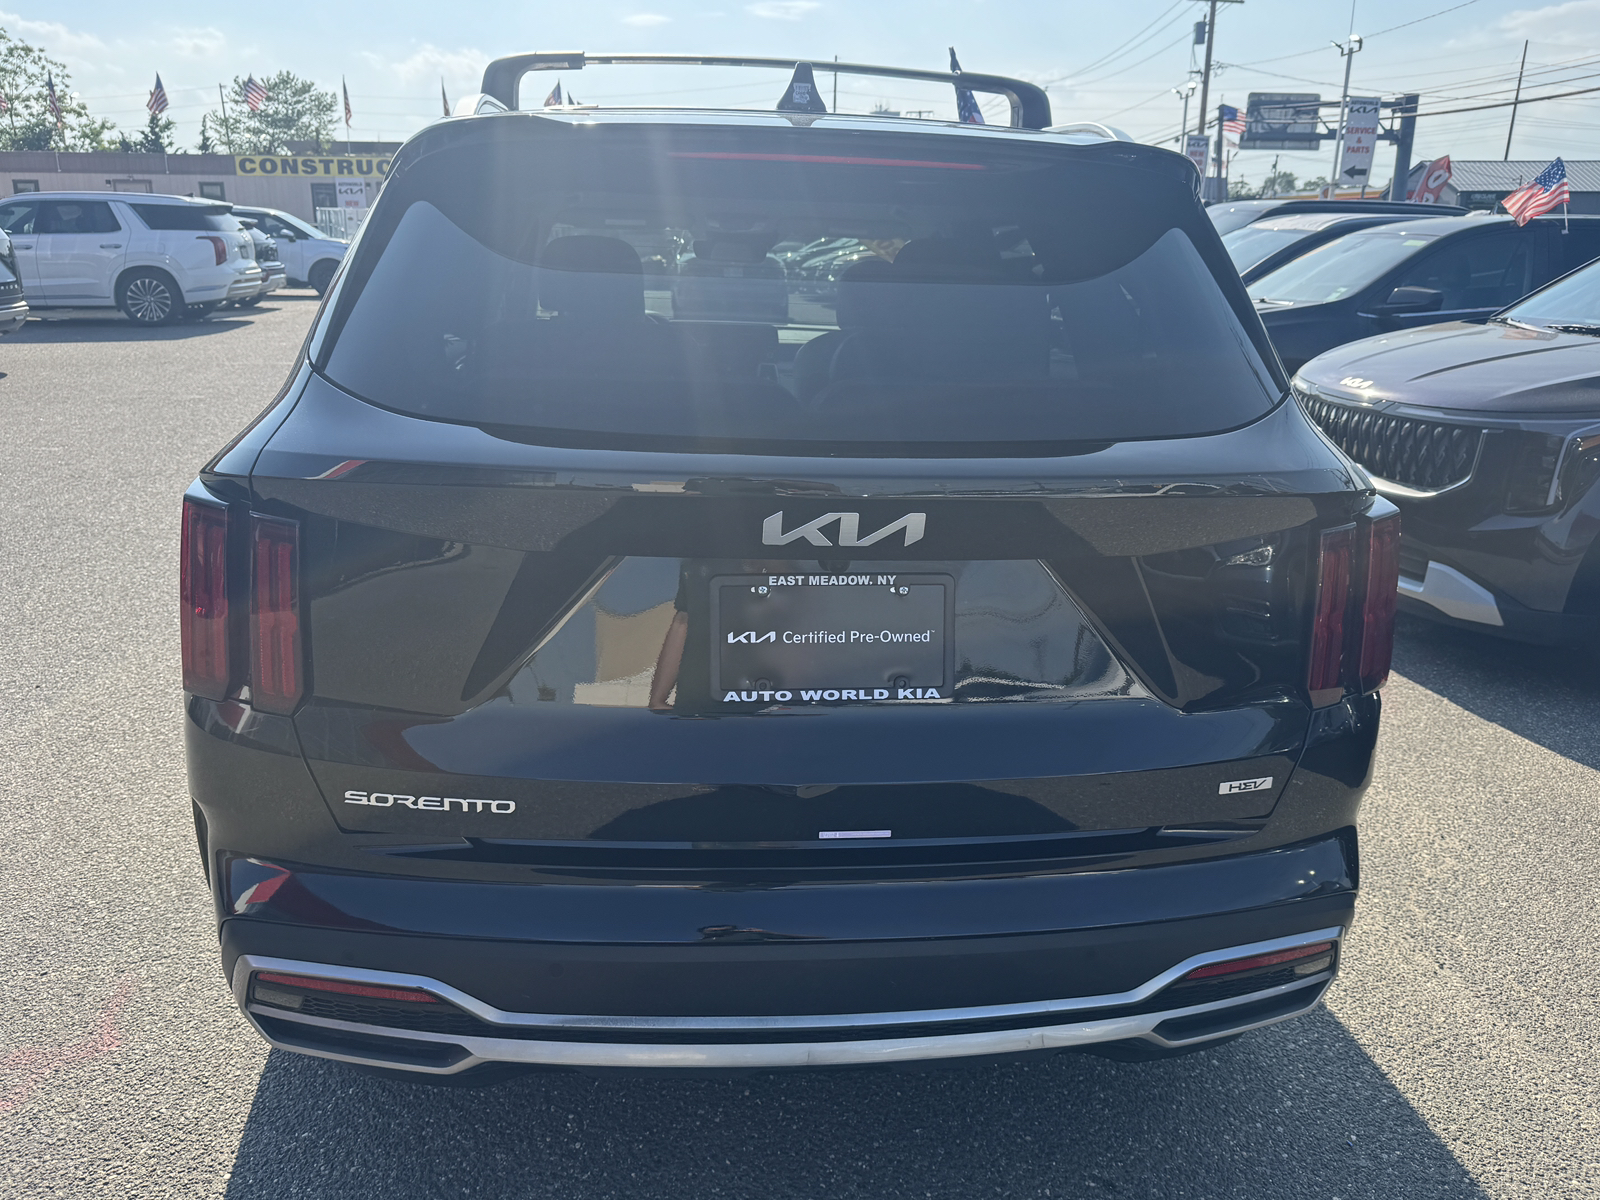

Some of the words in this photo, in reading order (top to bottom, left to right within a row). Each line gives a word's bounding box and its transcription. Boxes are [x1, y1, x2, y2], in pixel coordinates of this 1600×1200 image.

[762, 511, 926, 547] KIA
[769, 575, 804, 586] EAST
[877, 575, 897, 586] NY
[727, 631, 776, 644] KIA
[782, 631, 846, 644] Certified
[723, 690, 793, 702] AUTO
[800, 689, 890, 701] WORLD
[897, 688, 941, 699] KIA
[1228, 779, 1267, 792] HEV
[344, 790, 515, 814] SORENTO
